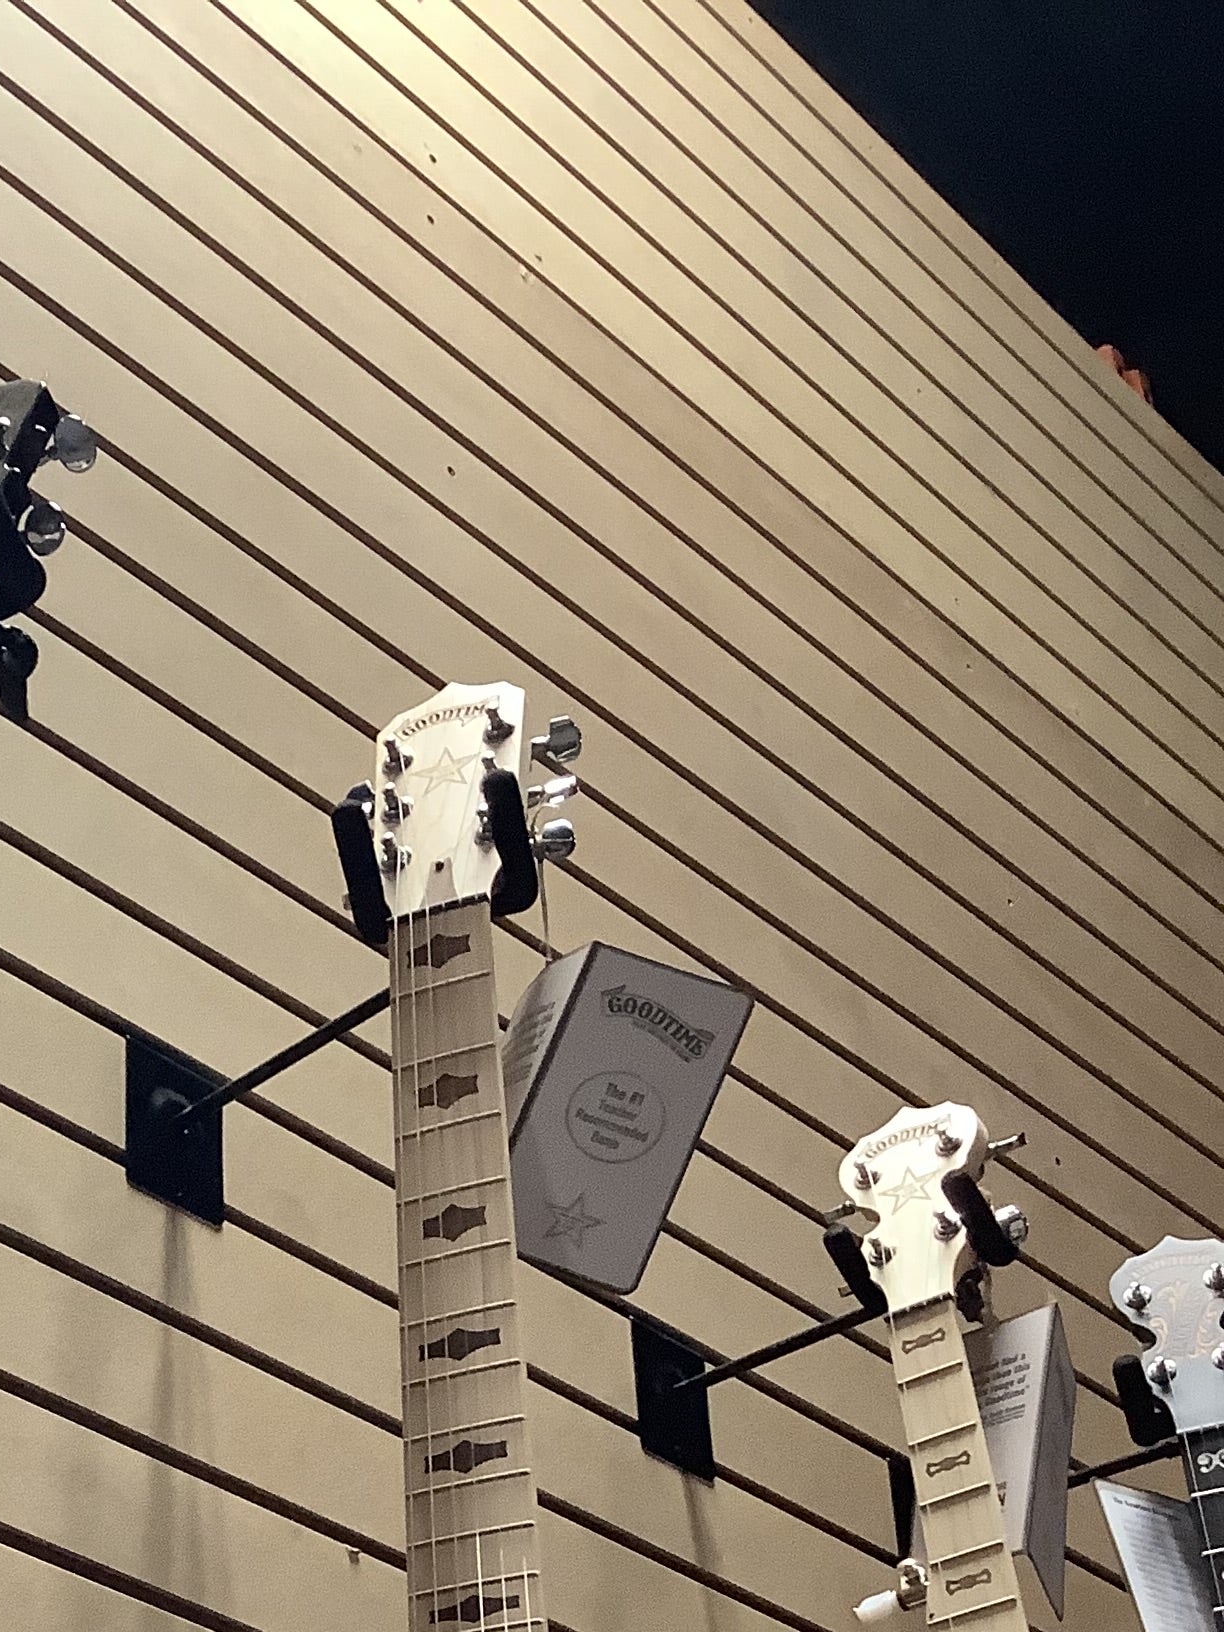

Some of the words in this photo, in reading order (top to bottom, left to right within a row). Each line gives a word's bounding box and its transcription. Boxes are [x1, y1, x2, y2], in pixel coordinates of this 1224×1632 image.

[402, 704, 487, 736] GOODTIM
[607, 996, 706, 1056] GOODTIME
[865, 1123, 938, 1158] GOODTIM
